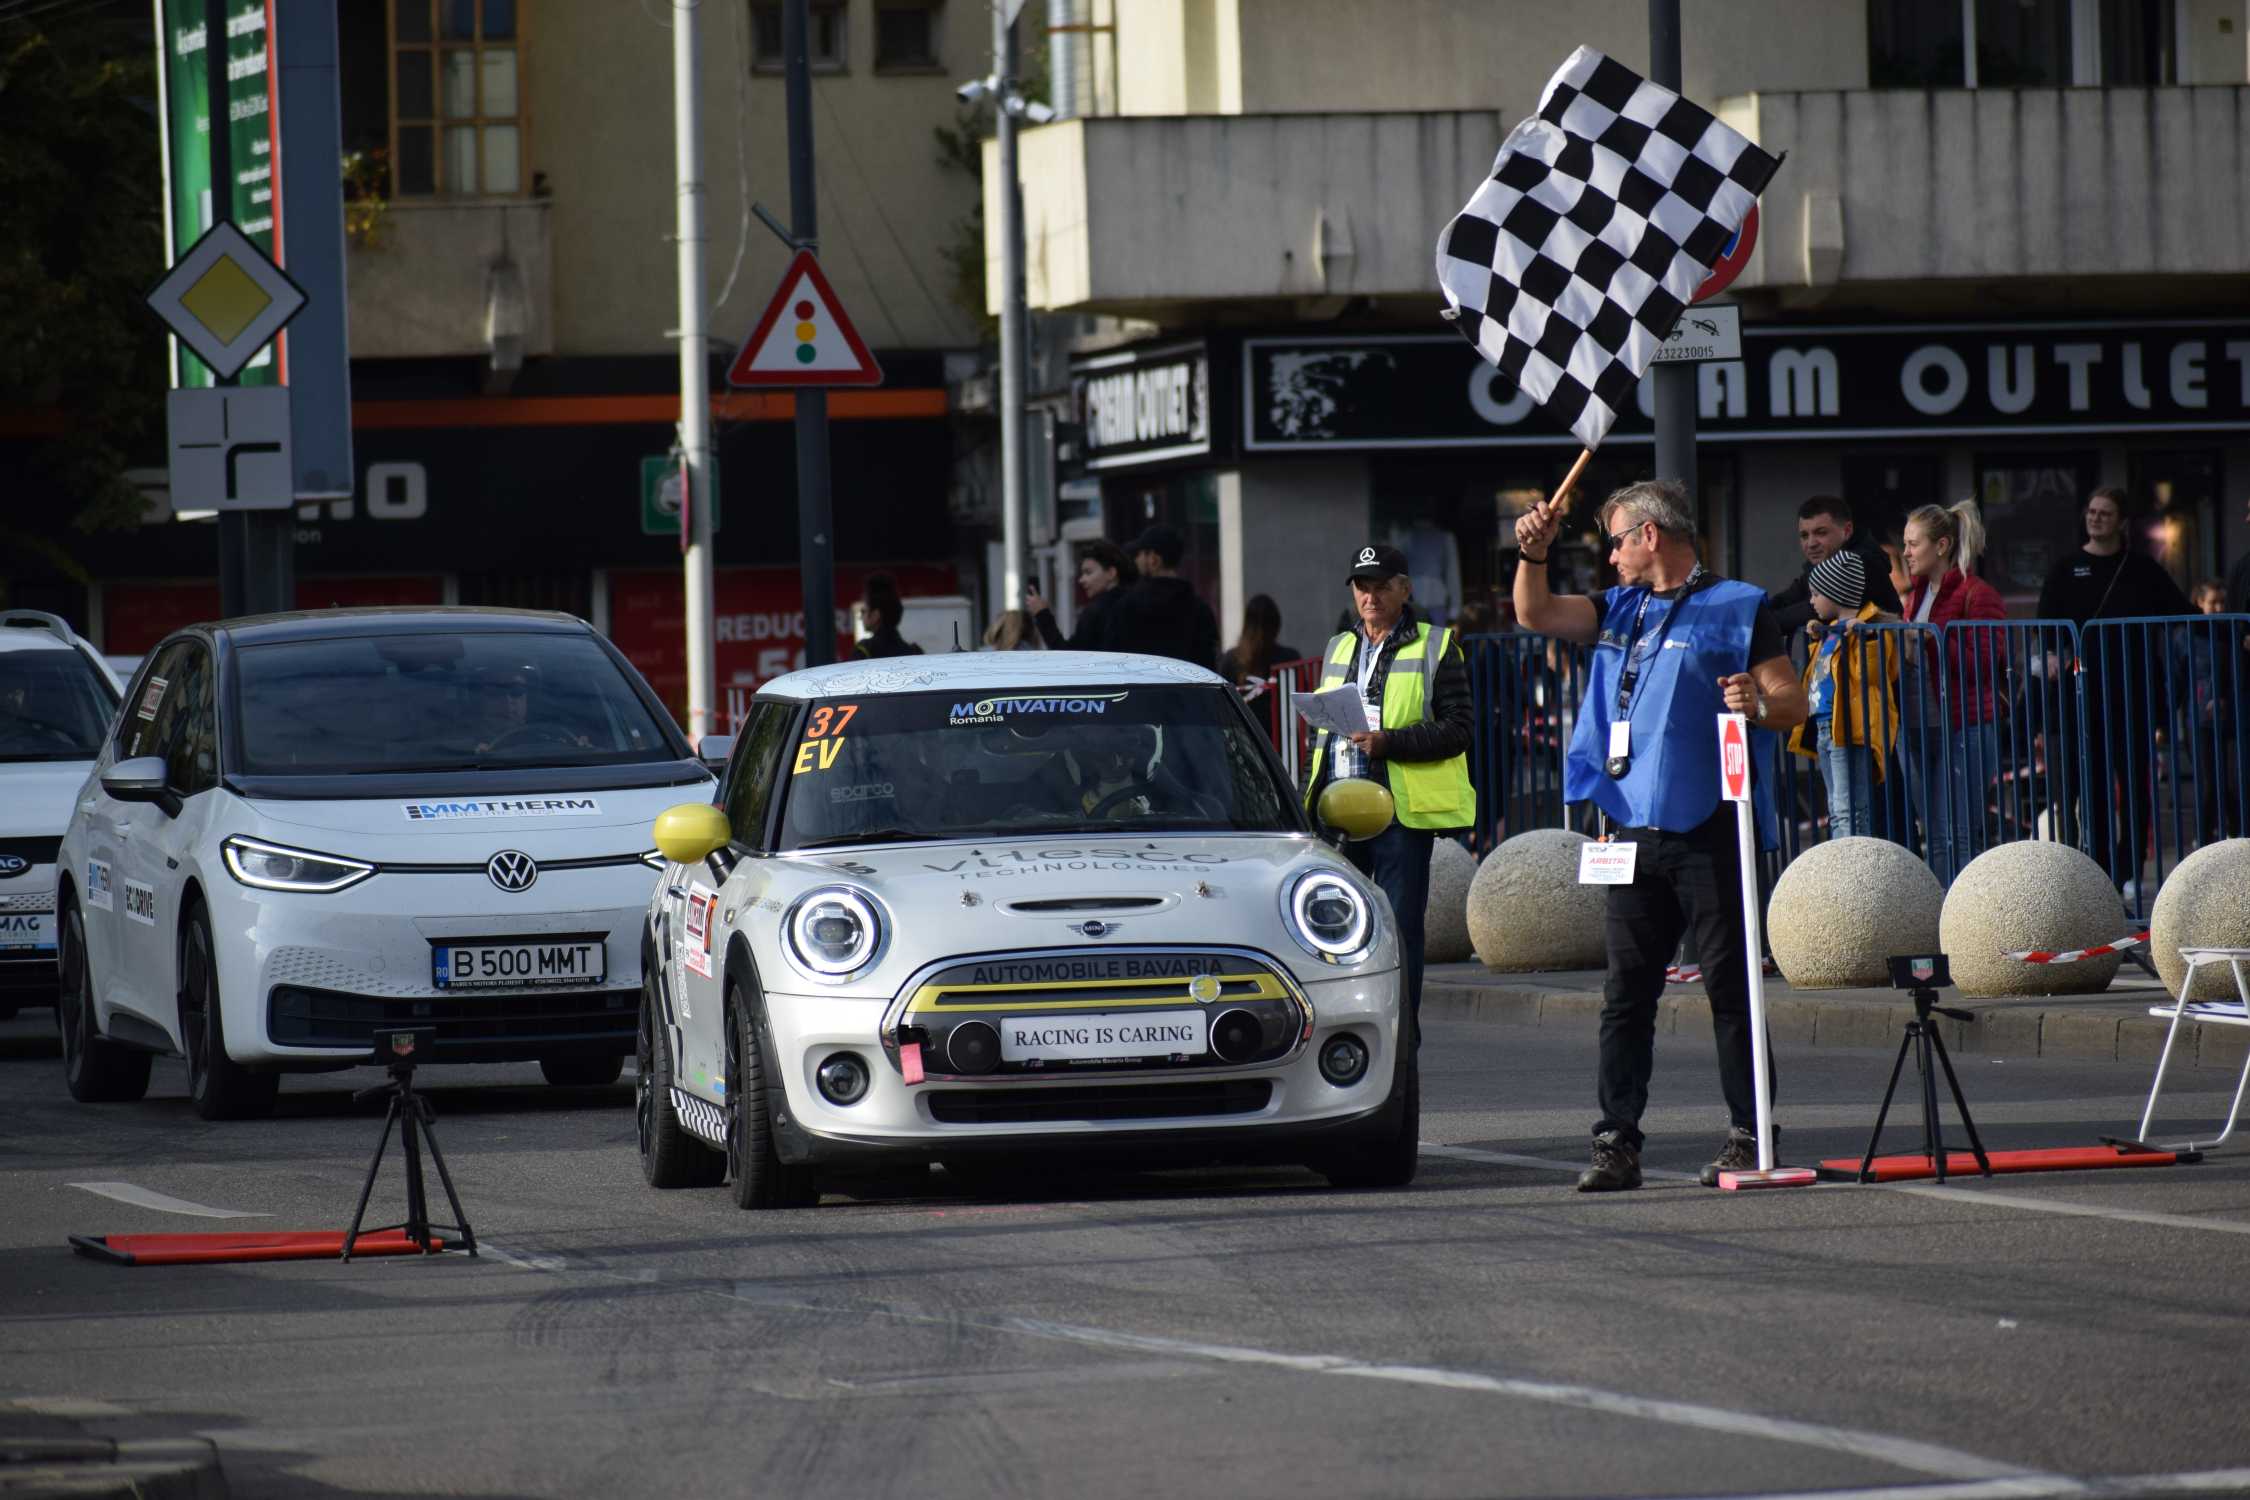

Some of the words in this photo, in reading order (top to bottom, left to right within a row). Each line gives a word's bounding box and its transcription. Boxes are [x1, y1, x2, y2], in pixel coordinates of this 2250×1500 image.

[716, 608, 855, 641] REDUCRI
[950, 699, 1106, 717] MOTIVATION
[808, 705, 859, 738] 37
[950, 715, 1004, 725] Romania
[793, 737, 846, 775] EV
[1727, 743, 1743, 775] STOP
[956, 861, 1212, 881] TECHNOLOGIES
[1083, 924, 1105, 933] MINI
[436, 967, 448, 978] RO
[454, 950, 474, 977] B
[481, 949, 531, 976] 500
[538, 946, 592, 974] MMT
[972, 960, 1121, 984] AUTOMOBILE
[1126, 958, 1225, 978] BAVARIA
[1015, 1029, 1089, 1047] RACING
[1095, 1027, 1113, 1044] IS
[1118, 1026, 1193, 1044] CARING
